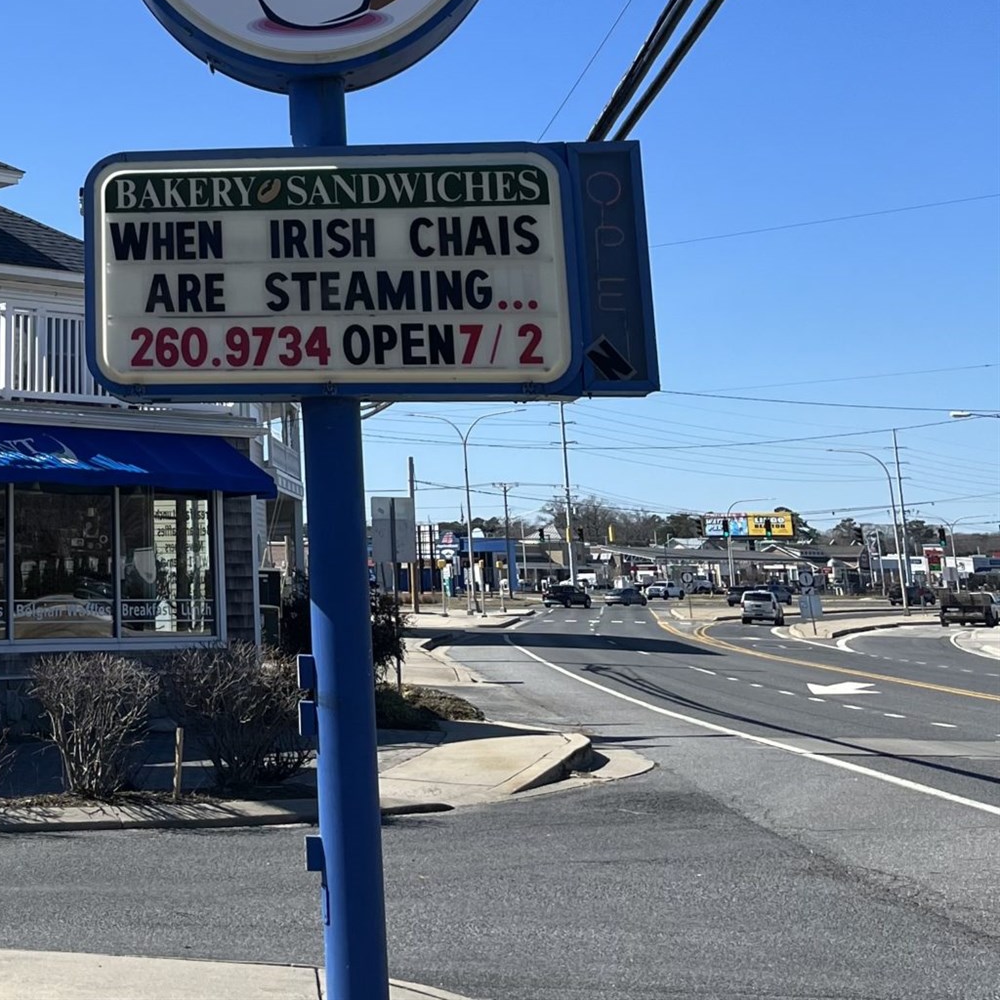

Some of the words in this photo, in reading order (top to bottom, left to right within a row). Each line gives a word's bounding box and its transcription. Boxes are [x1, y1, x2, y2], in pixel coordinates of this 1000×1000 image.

[115, 176, 256, 209] BAKERY
[286, 169, 541, 206] SANDWICHES
[109, 219, 224, 261] WHEN
[269, 218, 376, 259] IRISH
[409, 214, 540, 257] CHAIS
[144, 273, 226, 313] ARE
[264, 269, 538, 313] STEAMING...
[130, 325, 331, 367] 260.9734
[342, 322, 456, 366] OPEN
[16, 602, 62, 620] Belgian
[121, 602, 172, 617] Breakfast
[181, 602, 212, 617] Lunch
